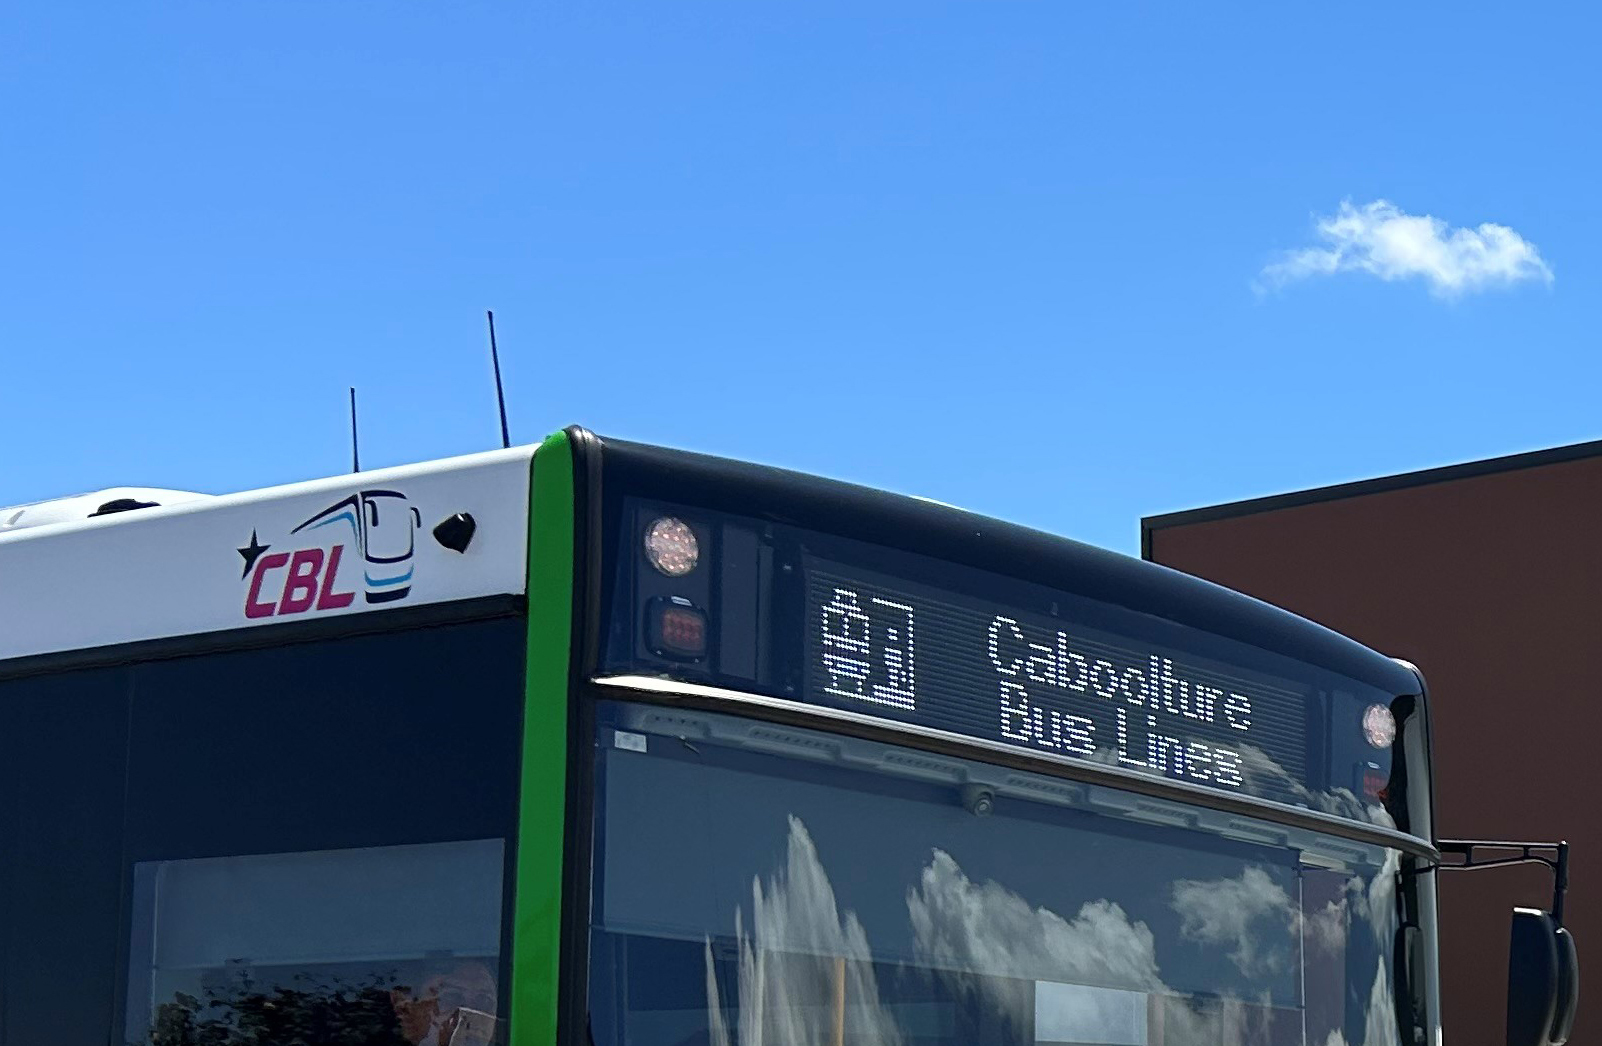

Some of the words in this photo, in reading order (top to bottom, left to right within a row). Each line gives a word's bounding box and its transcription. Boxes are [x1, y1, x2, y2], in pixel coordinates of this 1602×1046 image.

[245, 545, 356, 619] CBL
[988, 615, 1252, 731] Caboolture
[1000, 679, 1096, 756] Bus
[1117, 707, 1243, 786] Lines
